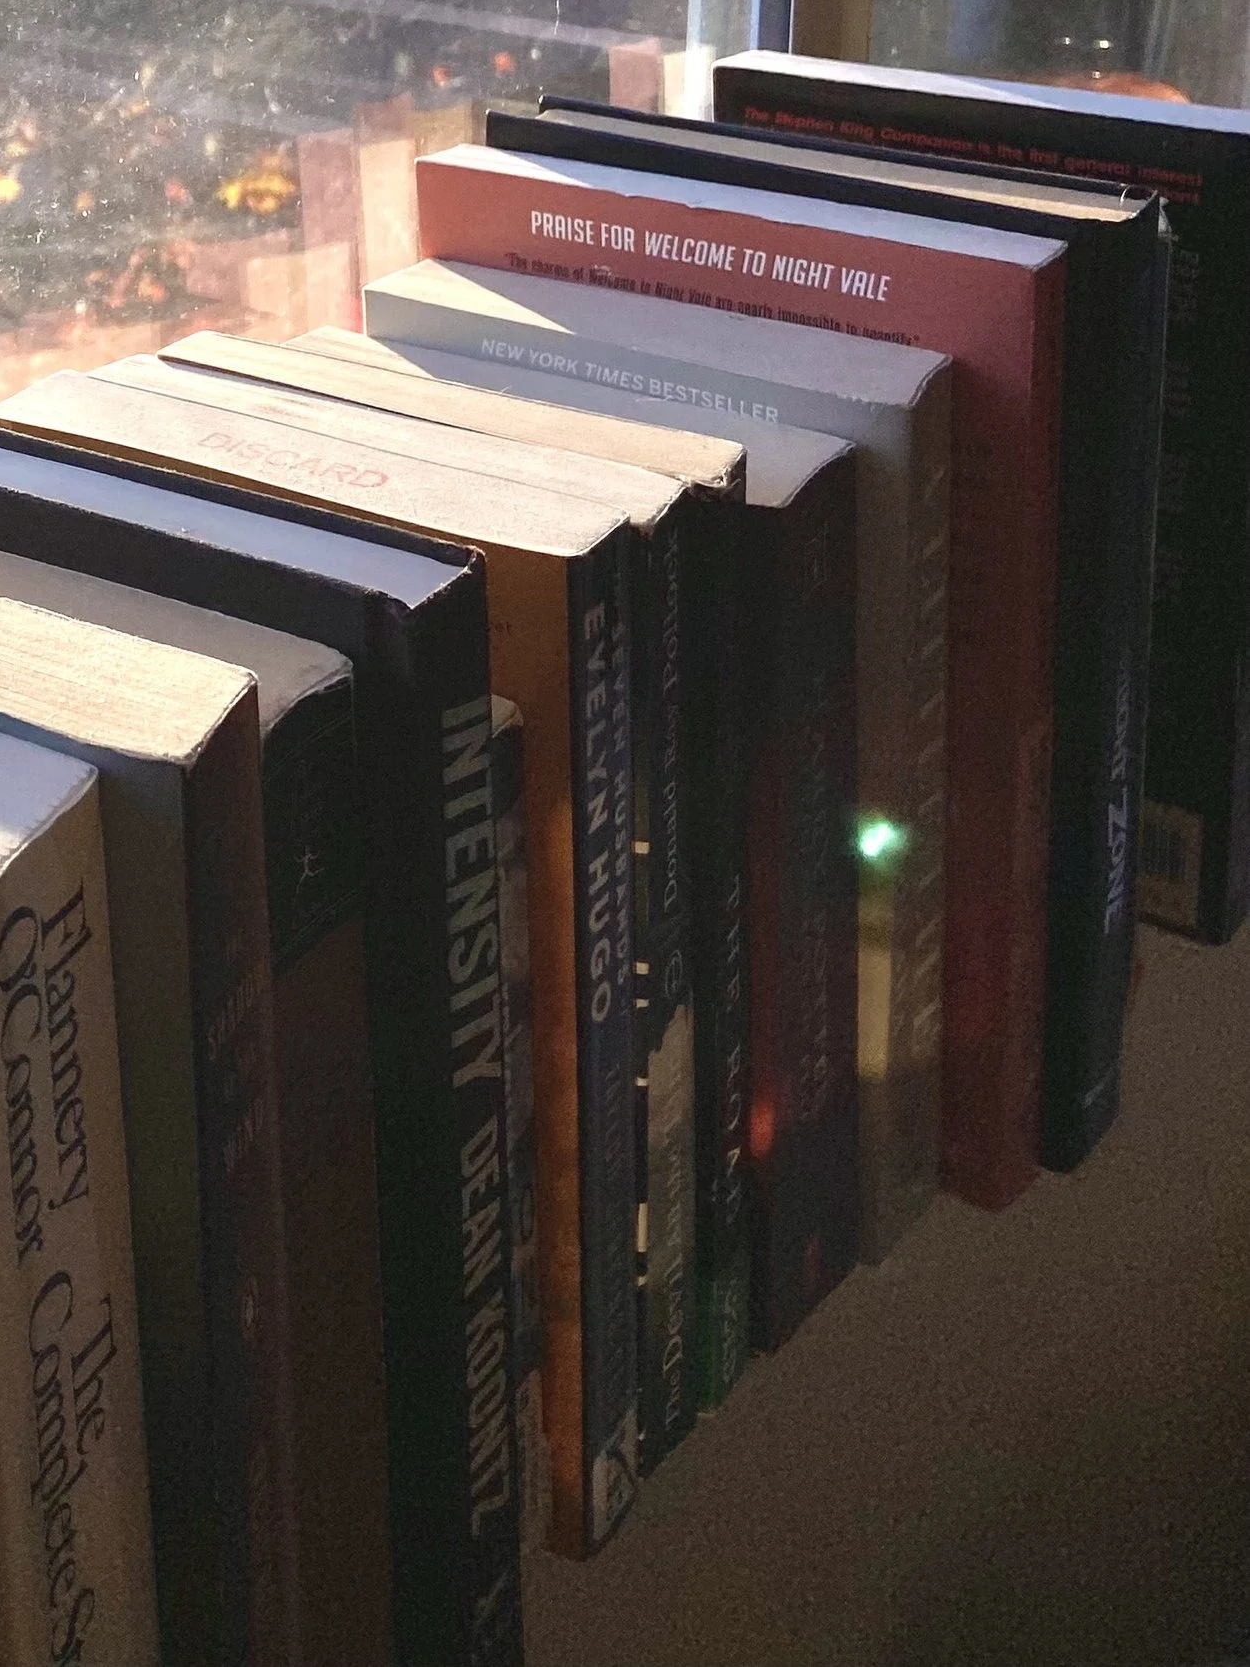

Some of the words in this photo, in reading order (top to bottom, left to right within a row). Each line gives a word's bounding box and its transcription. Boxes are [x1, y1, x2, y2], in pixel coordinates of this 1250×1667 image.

[744, 106, 770, 123] The
[775, 110, 835, 134] Stephen
[840, 118, 874, 141] King
[881, 124, 974, 156] Companion
[998, 140, 1023, 162] the
[1063, 154, 1131, 180] general
[530, 210, 595, 246] PRAISE
[601, 222, 635, 253] FOR
[644, 230, 736, 272] WELCOME
[742, 249, 766, 277] TO
[772, 255, 836, 291] NIGHT
[841, 268, 891, 303] VALE
[572, 262, 585, 281] of
[640, 277, 651, 297] to
[654, 280, 685, 304] Night
[688, 287, 712, 308] Vale
[715, 295, 734, 312] are
[737, 300, 774, 321] nearly
[777, 303, 843, 334] impossible
[846, 319, 858, 336] to
[481, 338, 526, 367] NEW
[529, 349, 579, 380] YORK
[585, 361, 645, 393] TIMES
[649, 376, 780, 425] BESTSELLER
[195, 431, 390, 490] DISCARD
[611, 619, 627, 754] SEVEN
[659, 527, 683, 694] Pollock
[583, 601, 611, 837] EVELYN
[441, 695, 502, 1089] INTENSITY
[612, 770, 630, 987] HUSBANDS
[660, 781, 680, 910] Donald
[1103, 786, 1129, 935] ZONE
[586, 850, 613, 1025] HUGO
[724, 875, 743, 1012] THE
[40, 876, 92, 1210] Flannery
[460, 1111, 502, 1298] DEAN
[724, 1042, 743, 1227] ROAD
[72, 1293, 118, 1455] The
[662, 1256, 684, 1377] Devil
[28, 1271, 87, 1607] Complete
[465, 1287, 510, 1540] KOONTZ
[663, 1376, 682, 1430] The
